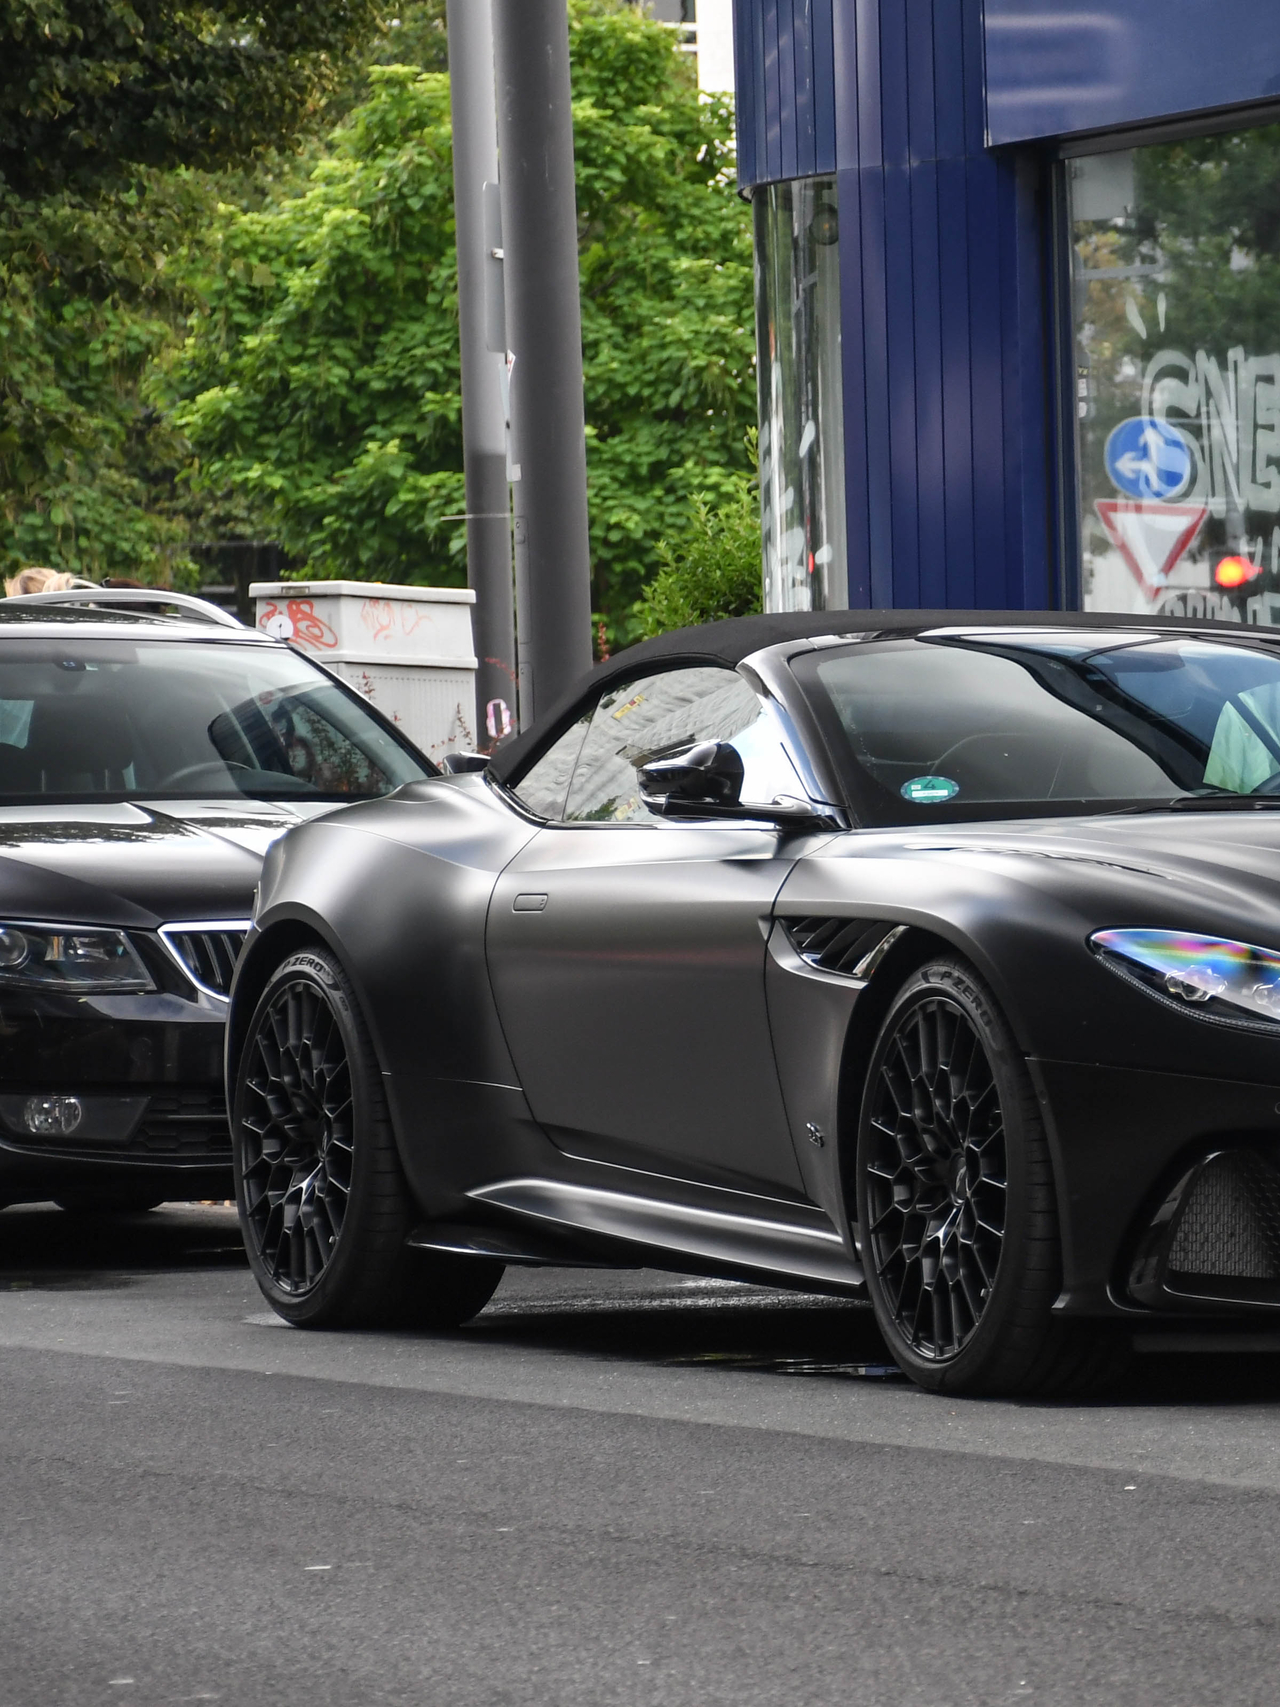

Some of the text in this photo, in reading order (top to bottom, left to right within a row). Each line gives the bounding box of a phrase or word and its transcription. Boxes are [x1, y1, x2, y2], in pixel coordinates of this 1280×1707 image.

[923, 780, 936, 790] 4
[291, 956, 324, 972] ZERO
[952, 977, 993, 1027] ZERO
